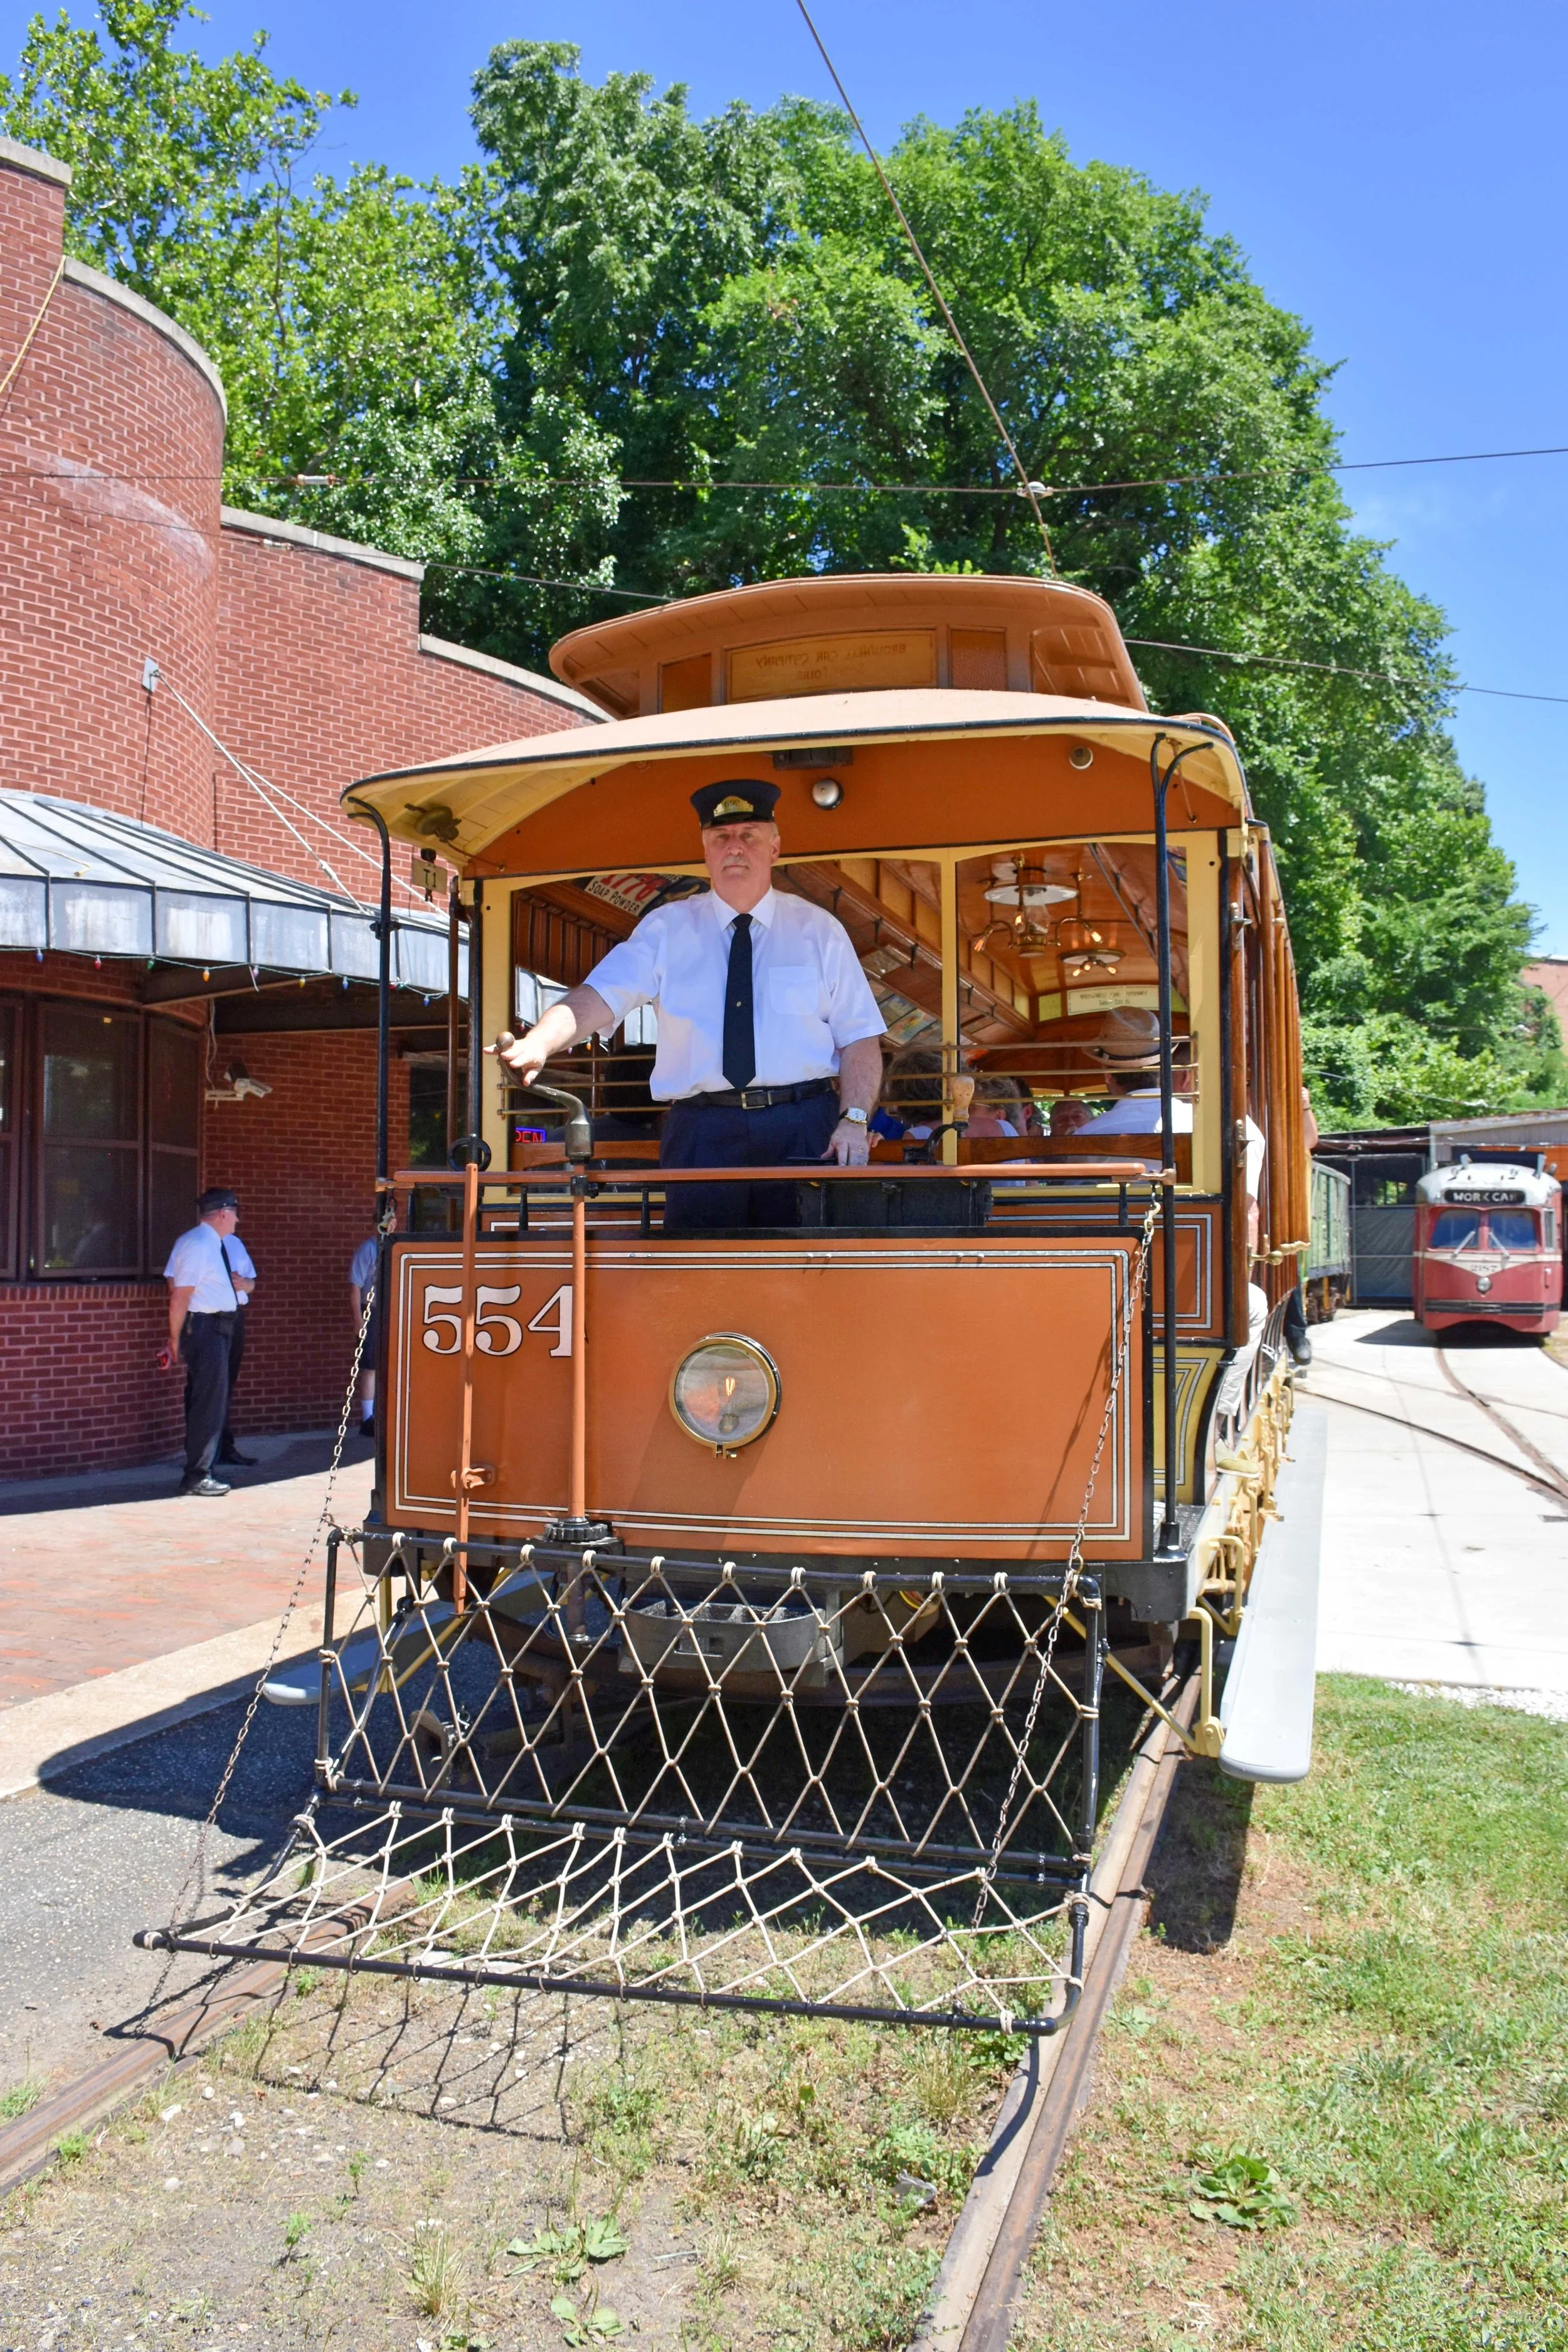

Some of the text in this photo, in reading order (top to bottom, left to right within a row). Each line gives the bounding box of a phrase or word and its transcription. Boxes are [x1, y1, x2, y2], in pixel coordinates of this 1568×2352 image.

[588, 881, 640, 914] SOAP POWDER
[1453, 1192, 1490, 1202] WORK
[423, 1284, 588, 1358] 554
